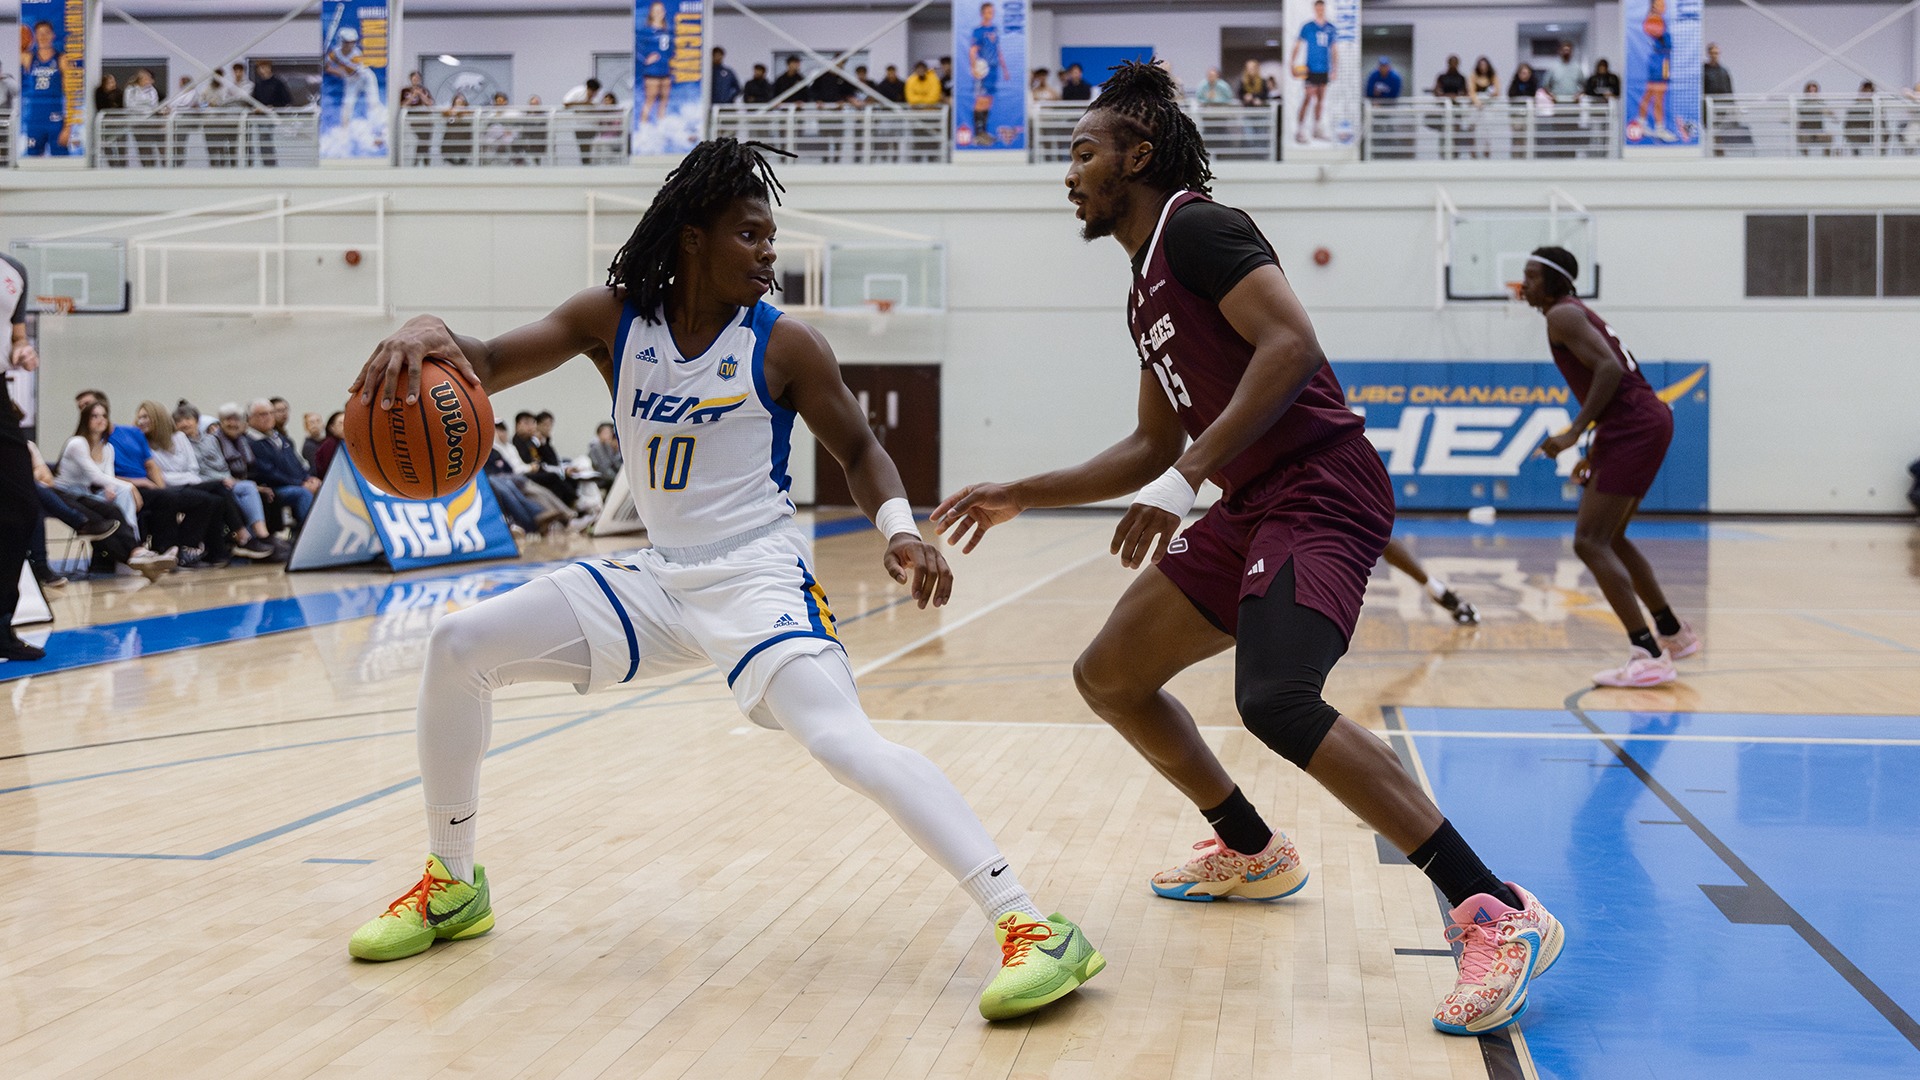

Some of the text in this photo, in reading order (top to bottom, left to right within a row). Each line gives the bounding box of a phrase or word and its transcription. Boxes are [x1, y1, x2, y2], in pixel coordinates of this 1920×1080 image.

[635, 353, 658, 365] adidas
[631, 388, 750, 424] HEAT
[1347, 385, 1569, 404] UBC OKANAGAN
[392, 397, 420, 484] EVOLUTION
[429, 380, 469, 480] Wilson
[1353, 406, 1592, 476] HEA
[646, 434, 697, 492] 10
[373, 482, 487, 559] HEAT
[773, 620, 799, 629] adidas
